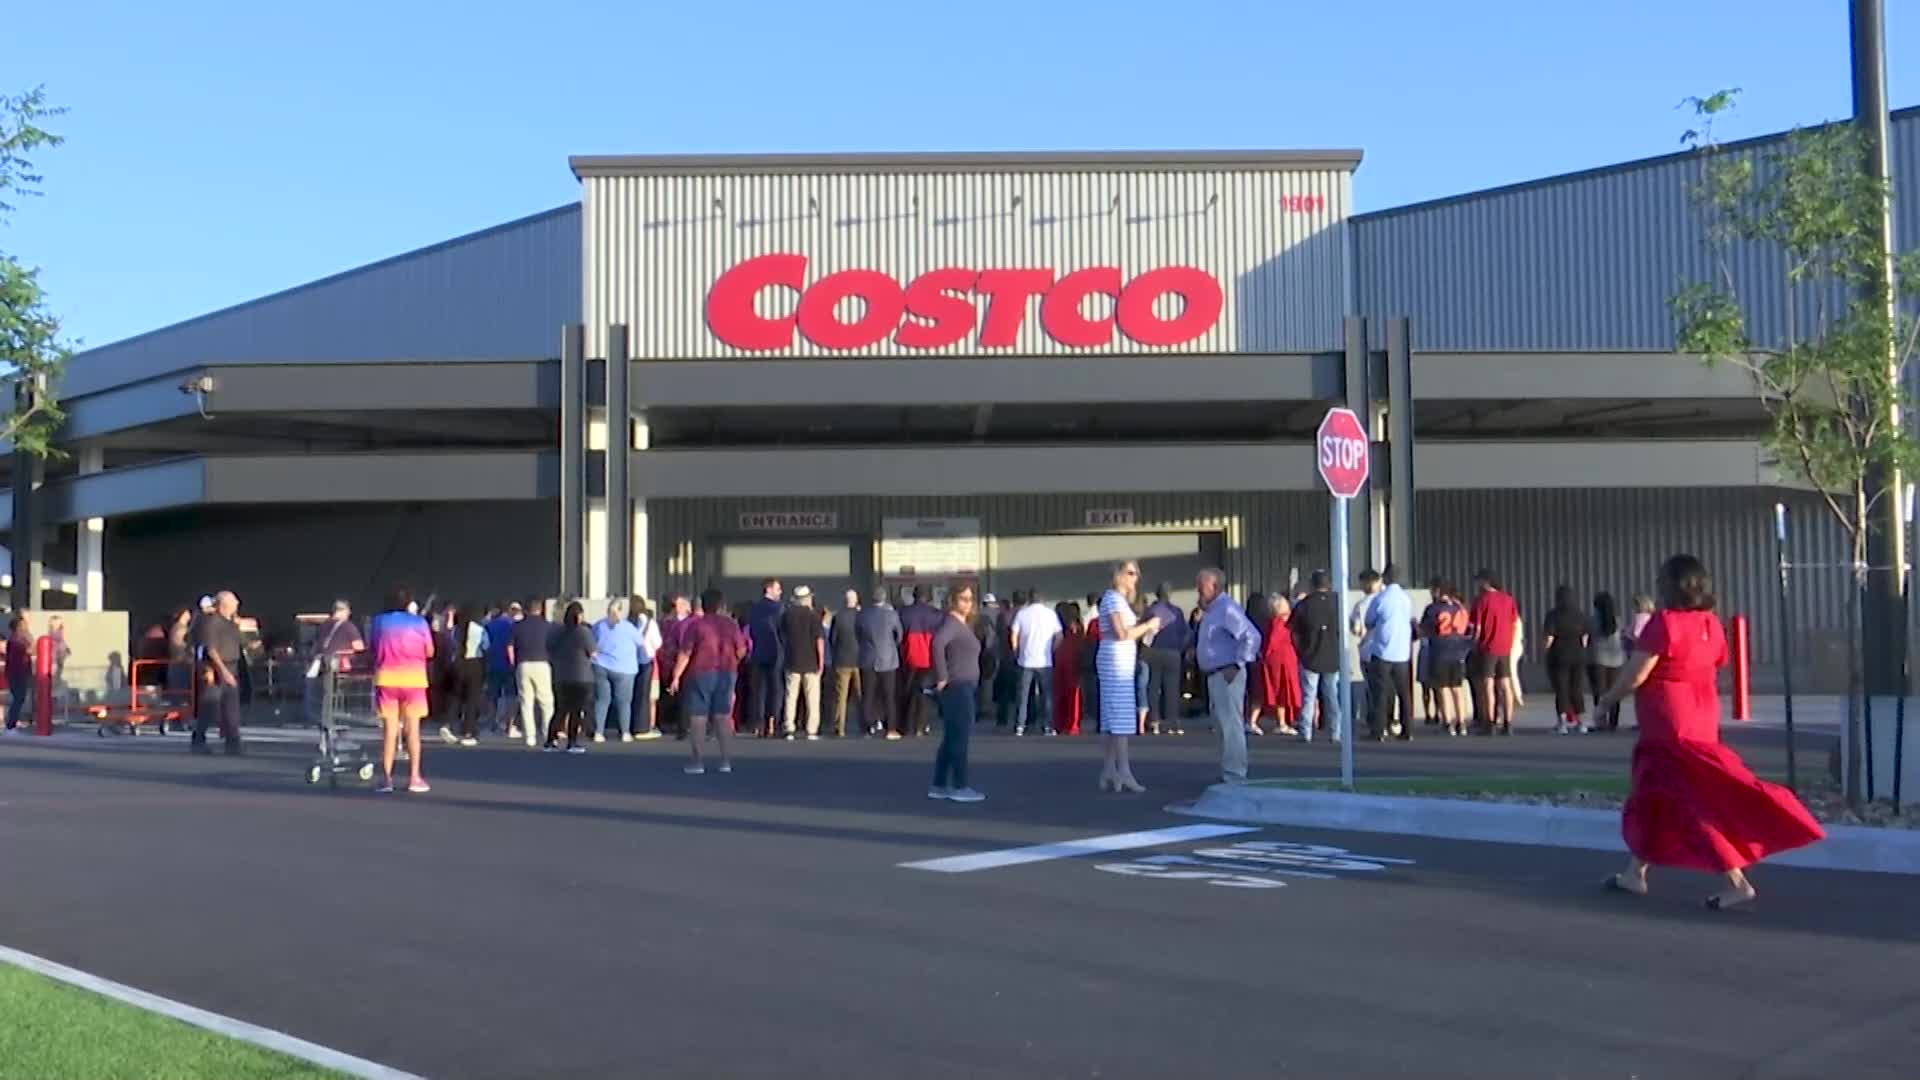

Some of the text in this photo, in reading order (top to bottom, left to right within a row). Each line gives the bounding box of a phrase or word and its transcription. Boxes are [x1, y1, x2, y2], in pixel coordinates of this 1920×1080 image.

[706, 252, 1223, 352] COSTCO
[1322, 436, 1364, 470] STOP
[742, 514, 833, 527] ENTRANCE
[1089, 511, 1129, 524] EXIT
